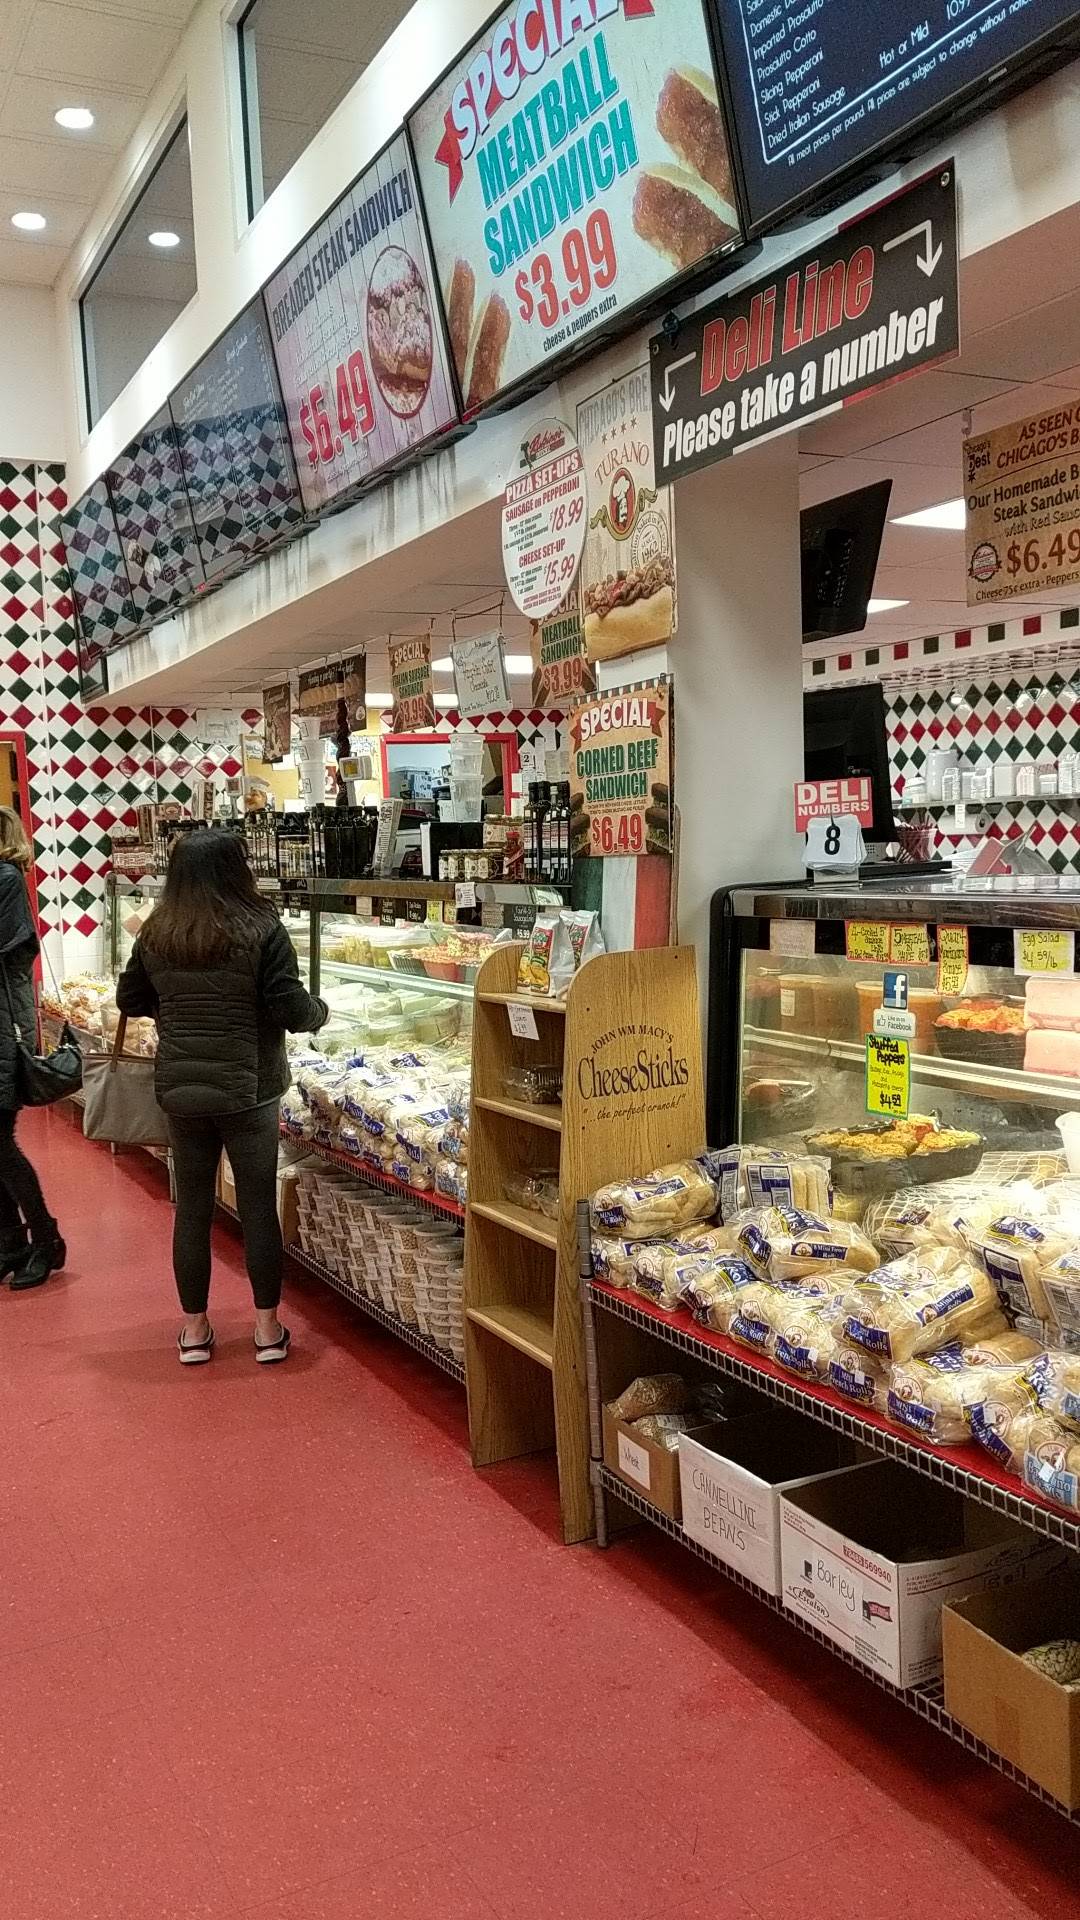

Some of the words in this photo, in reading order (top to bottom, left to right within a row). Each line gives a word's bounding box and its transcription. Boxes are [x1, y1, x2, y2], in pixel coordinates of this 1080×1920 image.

[750, 4, 782, 38] Domestic
[753, 23, 785, 60] Imported
[787, 0, 824, 32] Prosciutto
[757, 49, 791, 82] Prosciutto
[793, 30, 817, 52] Cotto
[767, 125, 788, 148] Dried
[789, 112, 810, 134] Italian
[812, 86, 846, 117] Sausage
[880, 47, 895, 69] Hot
[898, 40, 908, 56] or
[911, 20, 929, 46] Mild
[946, 0, 970, 20] 10.9
[760, 81, 784, 105] Slicing
[785, 47, 824, 86] Pepperoni
[787, 155, 796, 167] All
[796, 144, 812, 161] meat
[813, 132, 831, 153] prices
[831, 124, 842, 141] per
[844, 105, 865, 132] pound
[867, 99, 875, 112] All
[876, 88, 896, 110] prices
[897, 76, 910, 91] are
[911, 57, 937, 82] subject
[938, 51, 947, 63] to
[950, 30, 978, 56] change
[979, 8, 1006, 35] without
[476, 30, 619, 210] MEATBALL
[764, 105, 780, 126] Stick
[782, 76, 820, 113] Pepperoni
[483, 97, 640, 278] SANDWICH
[272, 263, 315, 343] BREADED
[312, 225, 348, 292] STEAK
[345, 168, 413, 258] SANDWICH
[515, 208, 617, 329] $3.99
[543, 328, 566, 352] cheese
[566, 325, 572, 337] &
[571, 305, 599, 334] peppers
[599, 293, 618, 315] extra
[700, 284, 776, 397] Deli
[781, 245, 875, 355] Line
[663, 401, 735, 468] Please
[740, 369, 795, 432] take
[800, 360, 816, 405] a
[822, 295, 944, 396] number
[300, 347, 376, 474] $6.49
[1019, 421, 1036, 442] AS
[1038, 409, 1072, 435] SEEN
[594, 440, 650, 486] TURANO
[996, 431, 1068, 469] CHICAGO'S
[506, 474, 534, 504] PIZZA
[534, 450, 579, 489] SET-UPS
[968, 493, 991, 511] Our
[993, 468, 1067, 504] Homemade
[505, 498, 536, 522] SAUSAGE
[542, 475, 580, 505] PEPPERONI
[549, 495, 584, 533] $18.99
[994, 499, 1028, 524] Steak
[1004, 519, 1028, 538] with
[1030, 513, 1050, 531] Red
[519, 546, 542, 568] CHEESE
[542, 537, 566, 559] SET-UP
[543, 553, 575, 587] $15.99
[1007, 528, 1080, 578] $6.49
[975, 586, 1002, 601] Cheese
[1019, 578, 1041, 592] extra
[1046, 570, 1080, 586] Peppers
[394, 641, 425, 667] SPECIAL
[542, 657, 582, 693] $3.99
[399, 696, 424, 722] $3.99
[580, 697, 652, 742] SPECIAL
[576, 743, 625, 779] CORNED
[627, 737, 659, 770] BEEF
[585, 771, 648, 803] SANDWICH
[797, 779, 869, 806] DELI
[798, 801, 870, 816] NUMBERS
[592, 813, 643, 854] $6.49
[824, 825, 841, 856] 8
[1022, 932, 1036, 947] Egg
[1037, 931, 1060, 944] Salad
[591, 1029, 617, 1055] JOHN
[617, 1025, 636, 1037] WM
[638, 1024, 674, 1044] MACY'S
[868, 1034, 899, 1053] Stuffed
[887, 1021, 912, 1033] Facebook
[577, 1045, 689, 1100] CheeseSticks
[876, 1050, 906, 1067] Peppers
[612, 1101, 647, 1124] perfect
[749, 1328, 766, 1344] Rolls
[864, 1338, 889, 1352] Rolls
[850, 1384, 873, 1396] Rolls
[692, 1468, 757, 1531] CANNELLINI
[703, 1506, 747, 1551] BEANS
[817, 1559, 856, 1612] Barley
[863, 1559, 892, 1584] 569940
[799, 1590, 826, 1618] Escalon
